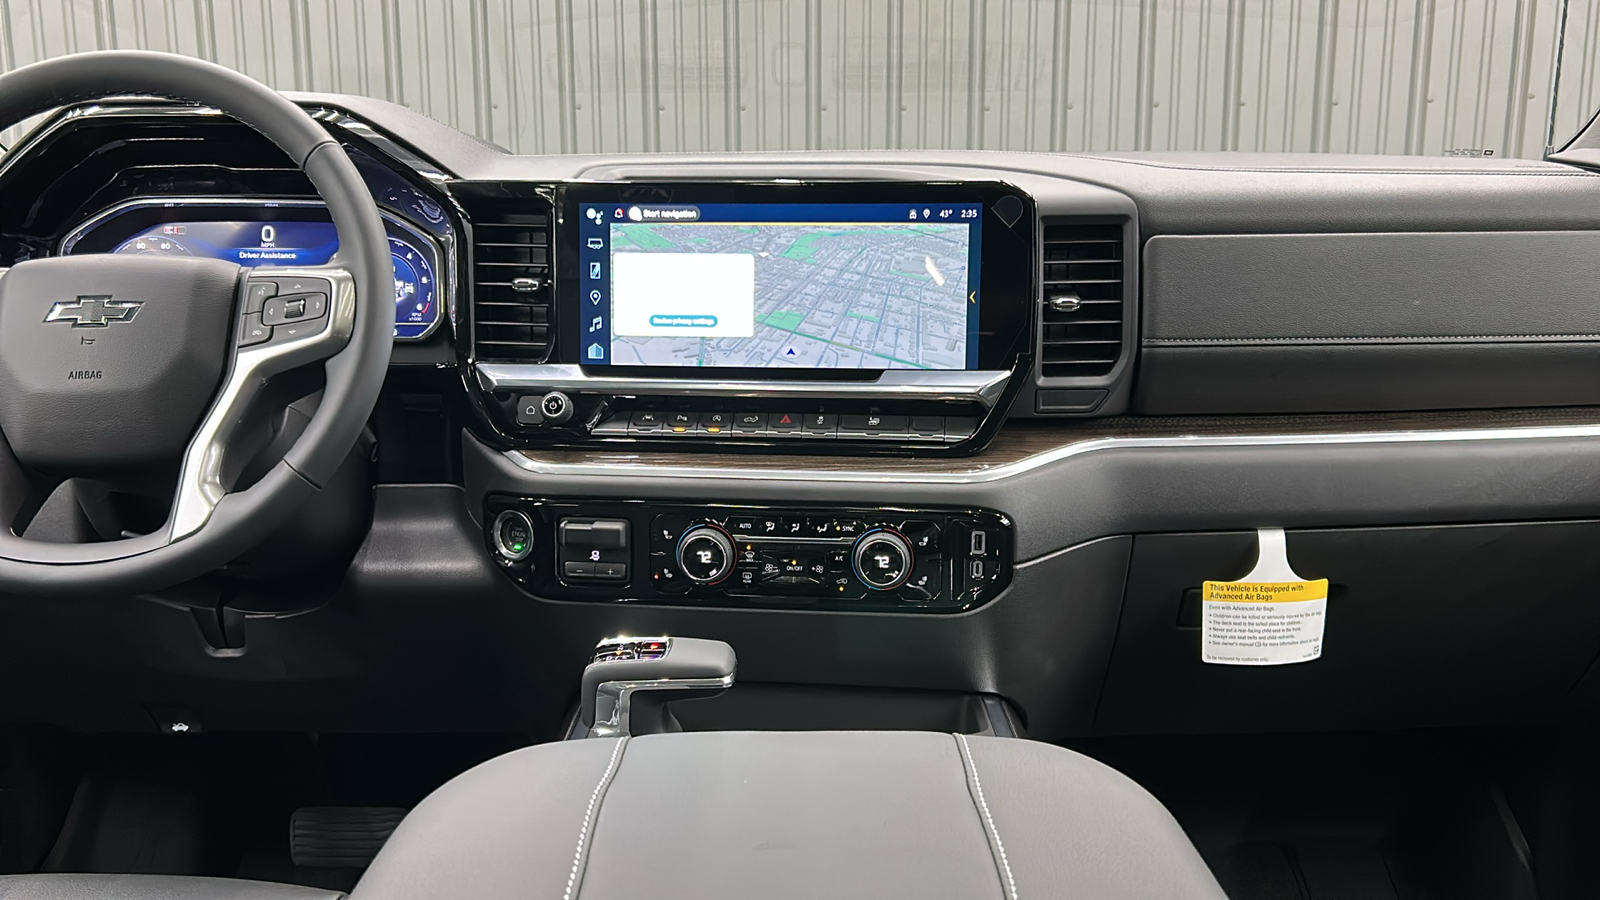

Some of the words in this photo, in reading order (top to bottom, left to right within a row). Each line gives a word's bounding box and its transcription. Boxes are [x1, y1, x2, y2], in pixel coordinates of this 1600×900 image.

[643, 209, 660, 218] Start
[661, 208, 696, 220] navigation
[961, 209, 978, 218] 2:35
[262, 225, 274, 242] 0
[68, 370, 102, 380] AIRBAG
[696, 550, 712, 563] 72
[874, 556, 890, 568] 72
[1260, 585, 1289, 594] Equipped
